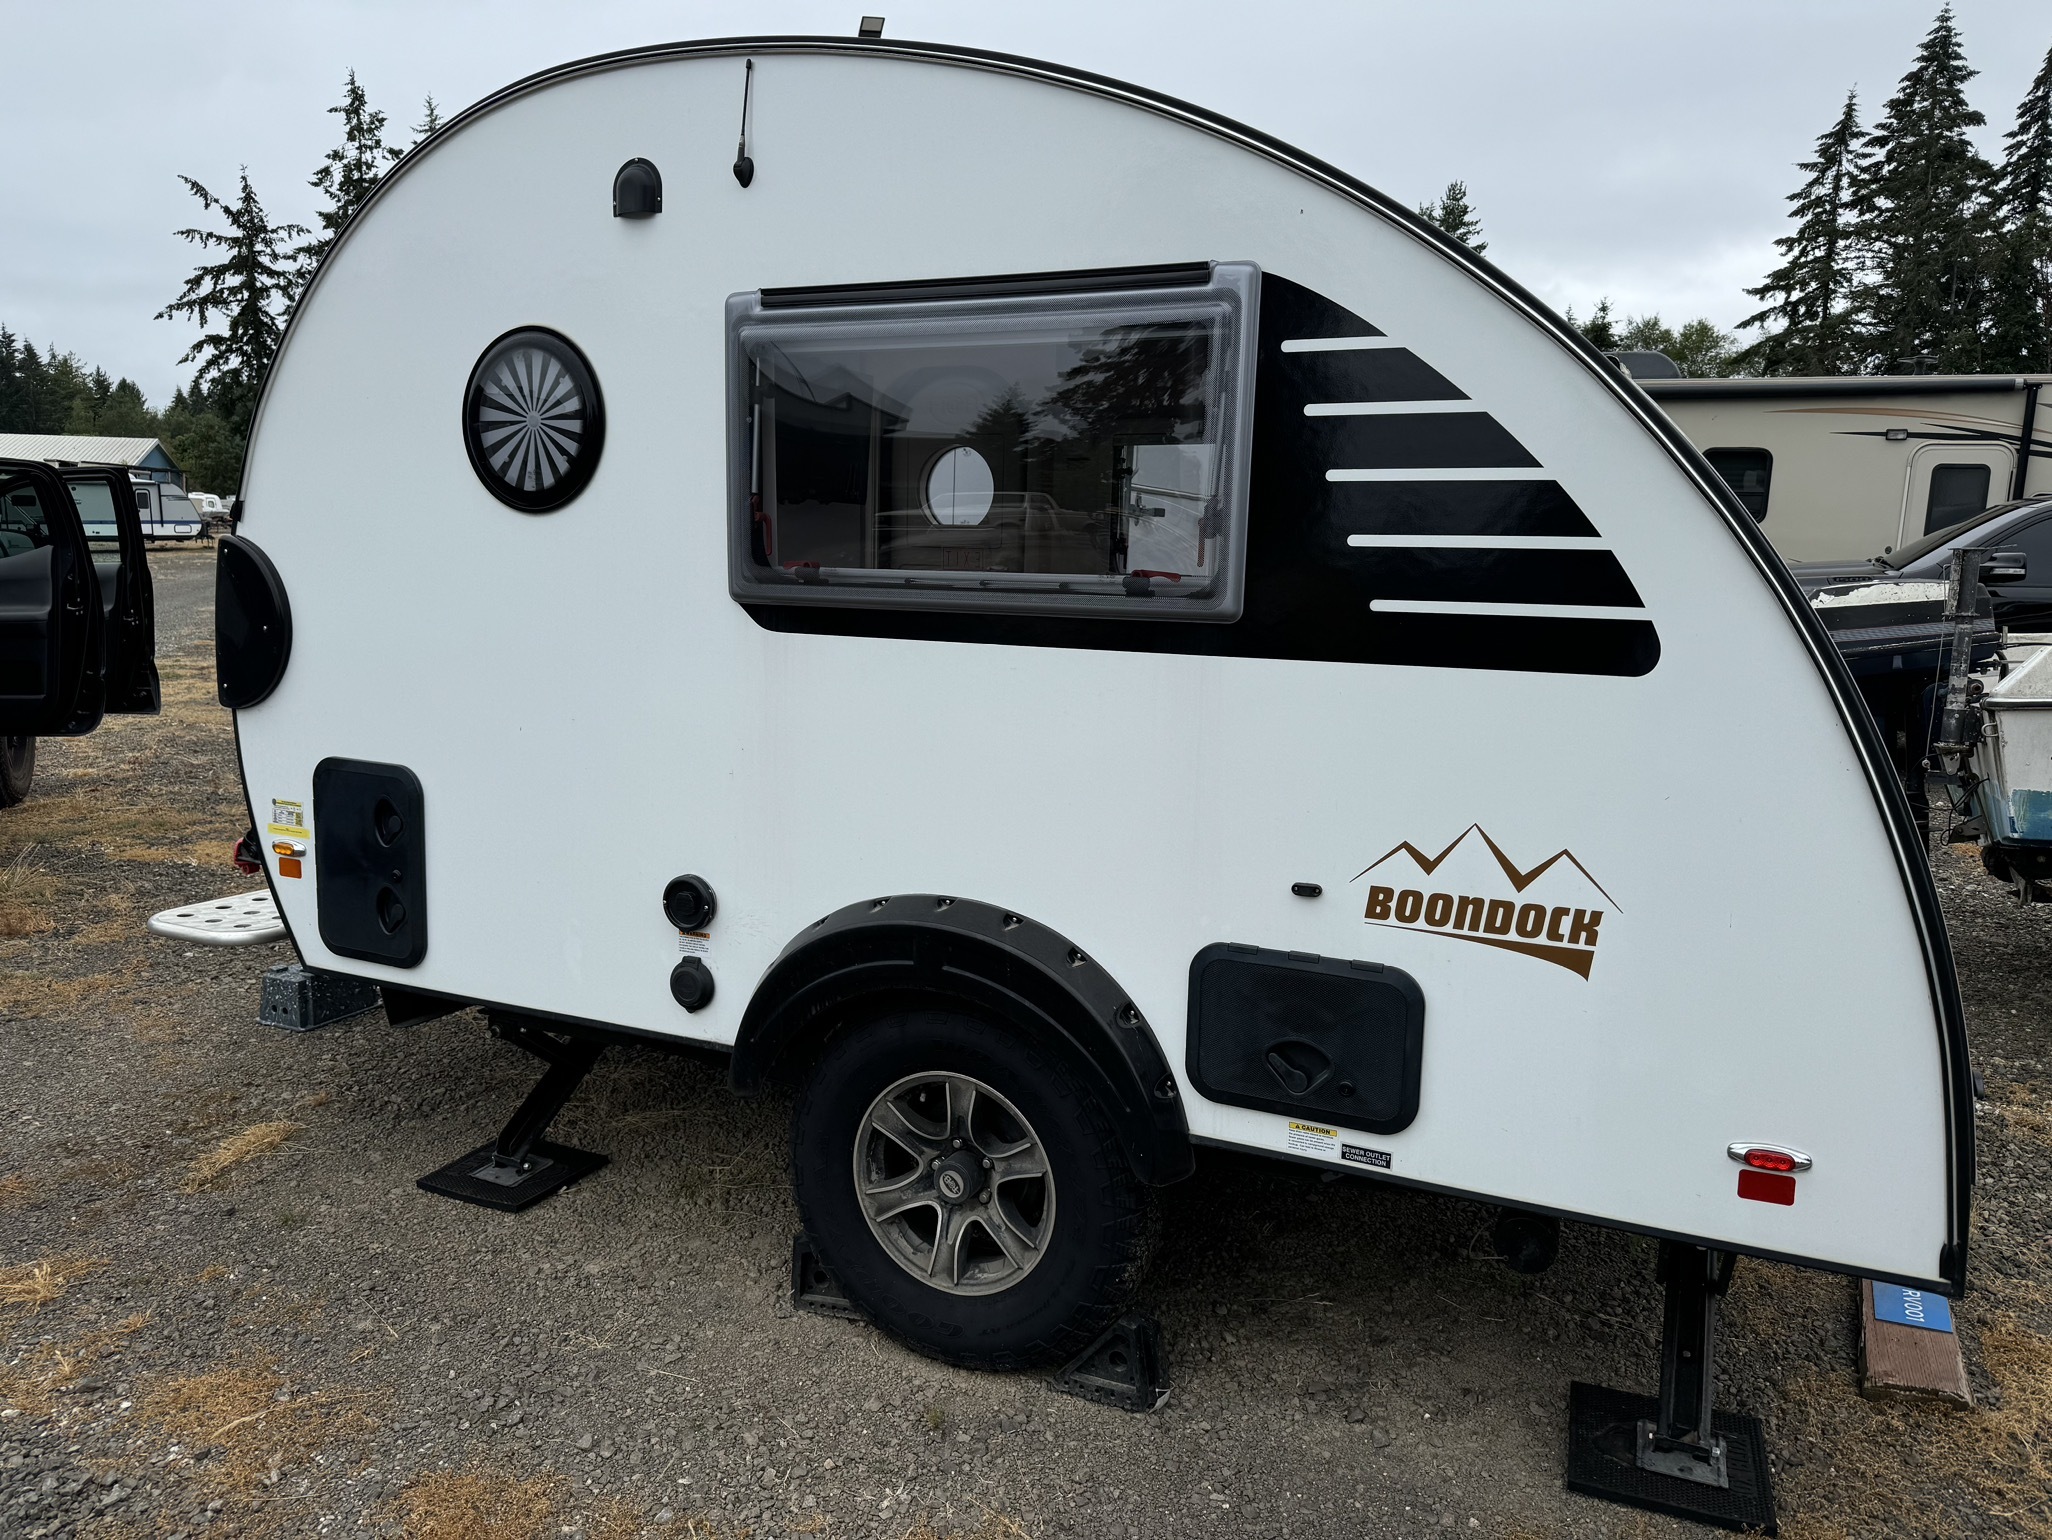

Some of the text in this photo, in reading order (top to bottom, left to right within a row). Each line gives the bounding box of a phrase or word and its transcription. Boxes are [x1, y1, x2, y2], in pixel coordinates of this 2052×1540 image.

[1364, 885, 1604, 947] BOONDOCK
[1301, 1124, 1331, 1135] CAUTION
[1342, 1146, 1391, 1161] SEWER OUTLET
[1345, 1153, 1387, 1166] CONNECTION
[1902, 1288, 1925, 1322] RV001
